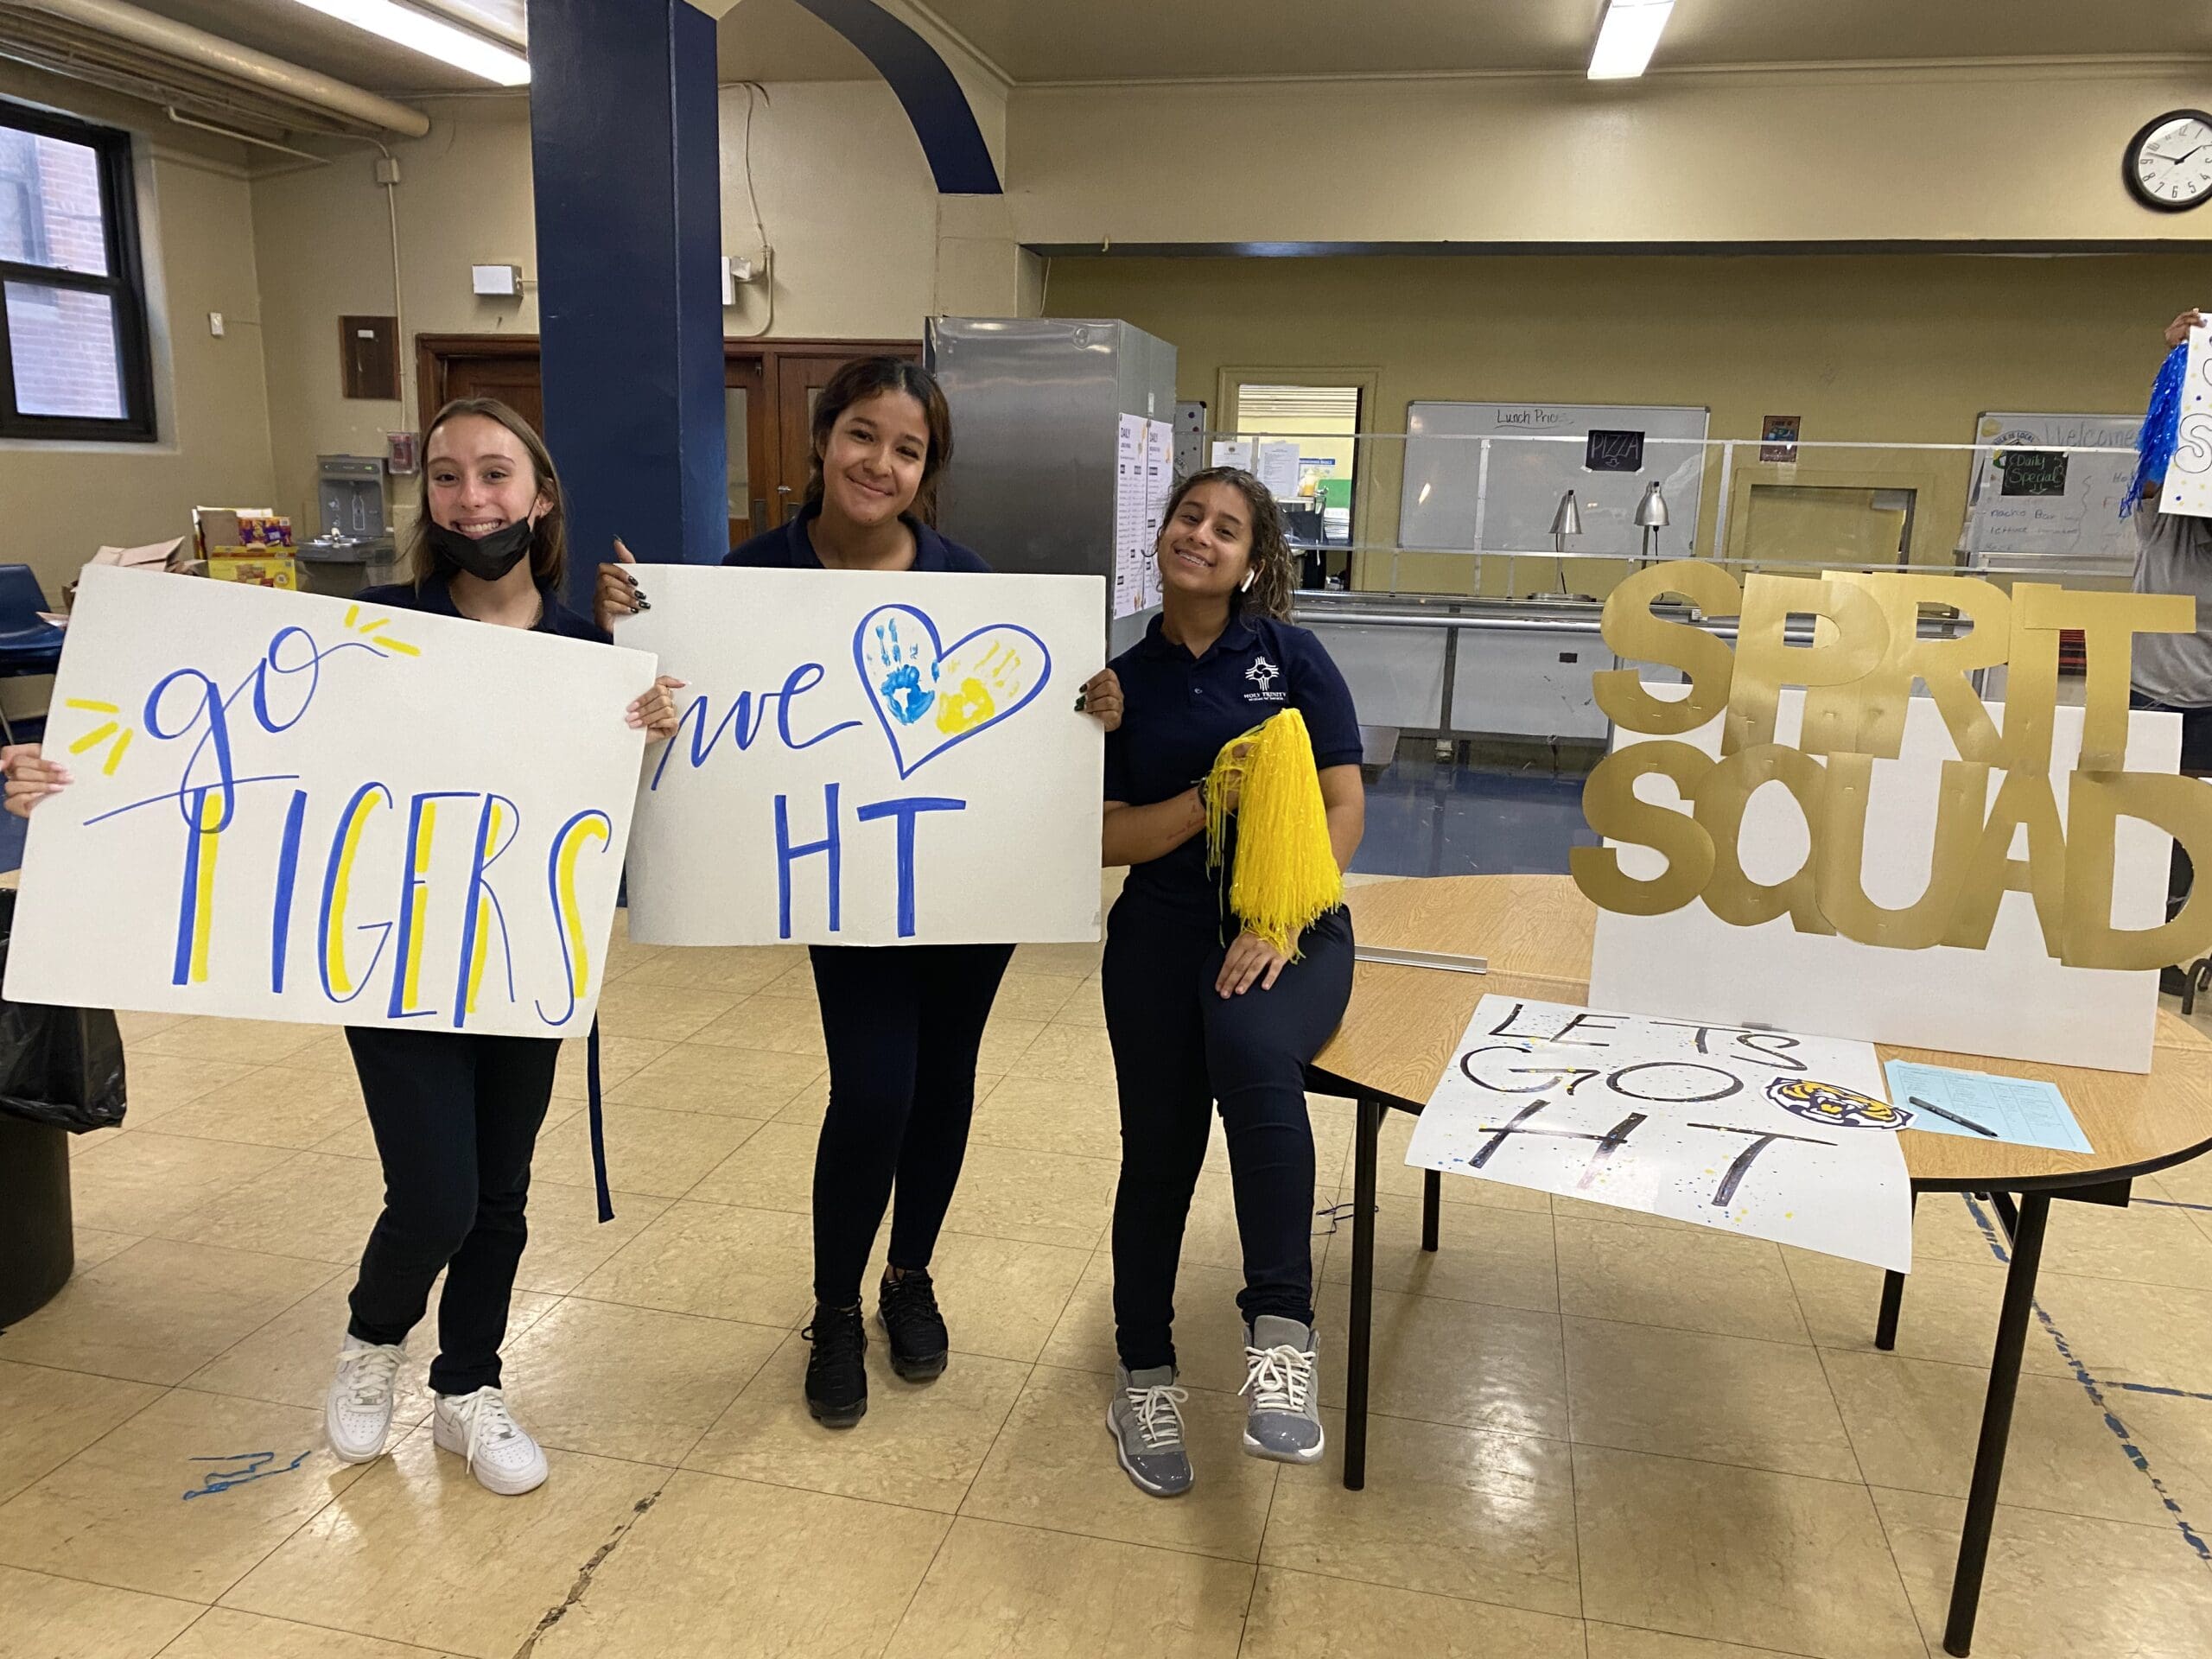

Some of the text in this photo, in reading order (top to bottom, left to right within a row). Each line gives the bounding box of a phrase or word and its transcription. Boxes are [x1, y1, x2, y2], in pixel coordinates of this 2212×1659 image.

[2143, 172, 2156, 181] 8
[2154, 181, 2164, 193] 7
[2172, 186, 2178, 198] 6
[2188, 181, 2196, 194] 5
[1497, 409, 1574, 424] Lunch Pric
[1591, 433, 1639, 459] PIZZA
[2017, 454, 2046, 470] Daily
[84, 626, 389, 834] go
[651, 663, 862, 791] we
[774, 783, 966, 939] HT
[1569, 740, 2212, 970] SQUAD
[172, 781, 613, 1028] TIGERS
[1460, 1046, 1745, 1103] GO
[1468, 1098, 1839, 1207] HT
